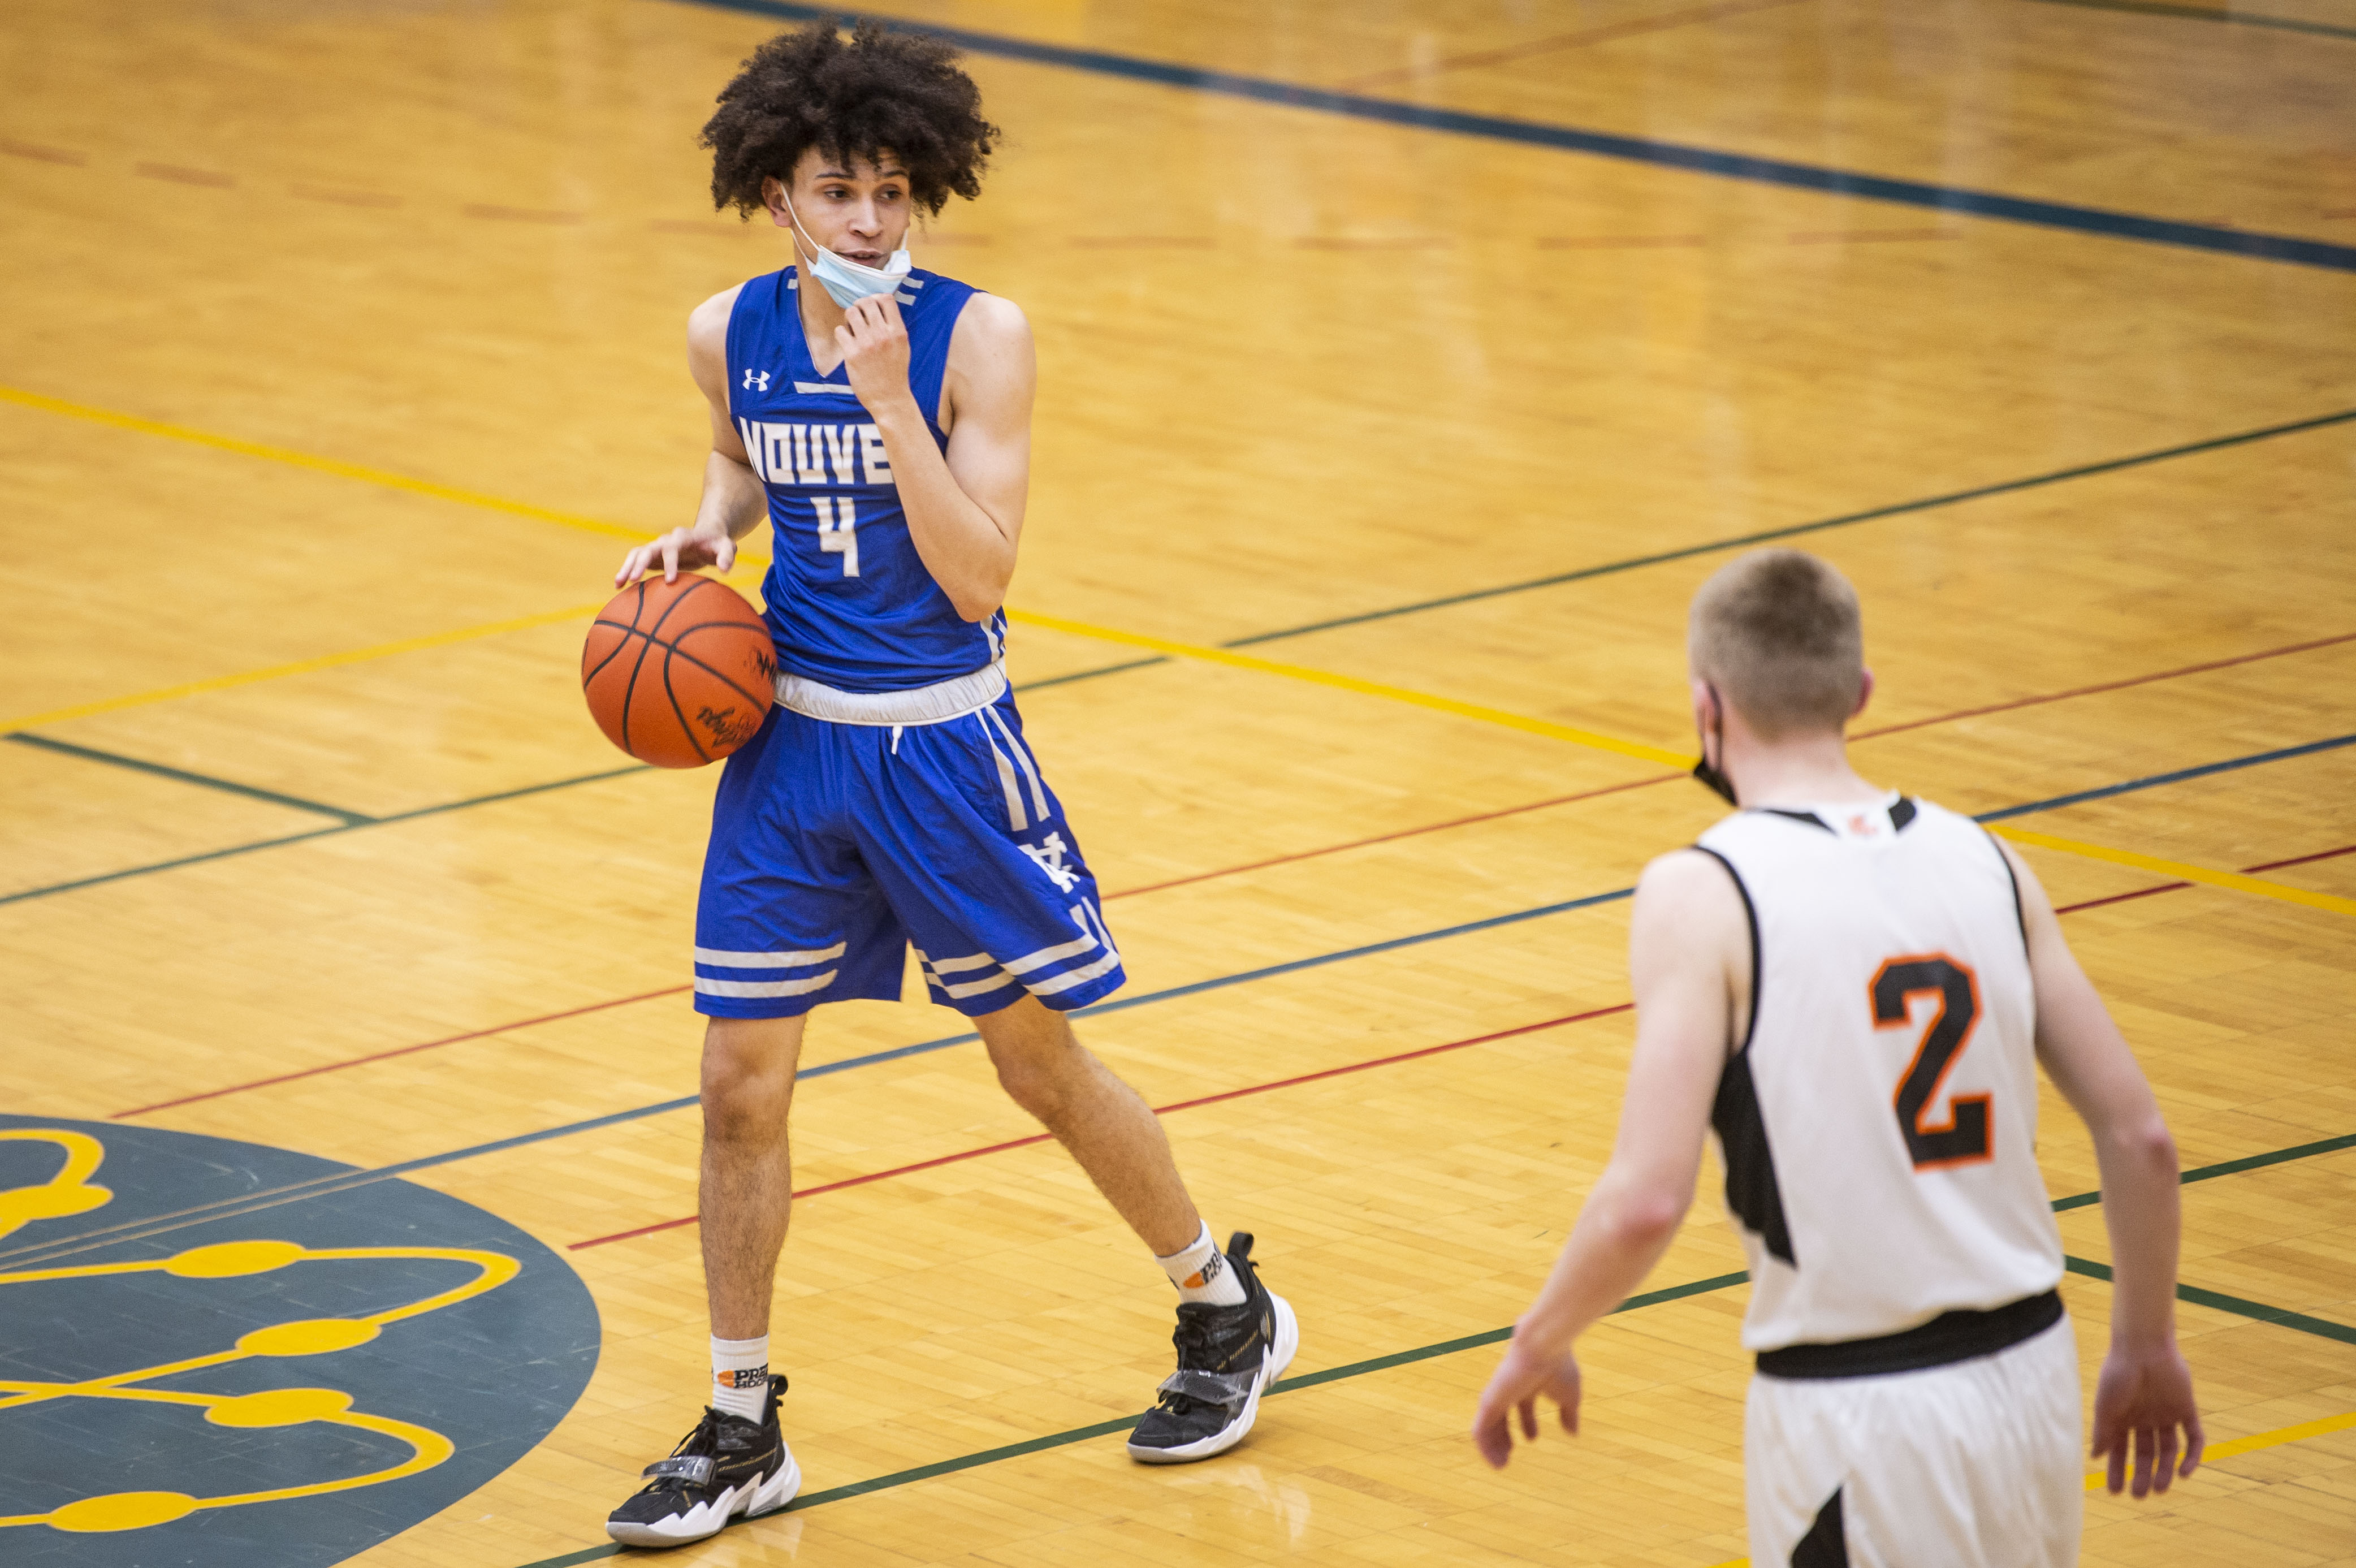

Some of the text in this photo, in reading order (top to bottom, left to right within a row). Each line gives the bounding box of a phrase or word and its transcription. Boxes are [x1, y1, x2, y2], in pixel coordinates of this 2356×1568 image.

[810, 496, 860, 577] 4
[1867, 951, 1994, 1174] 2
[734, 1362, 768, 1381] PRE
